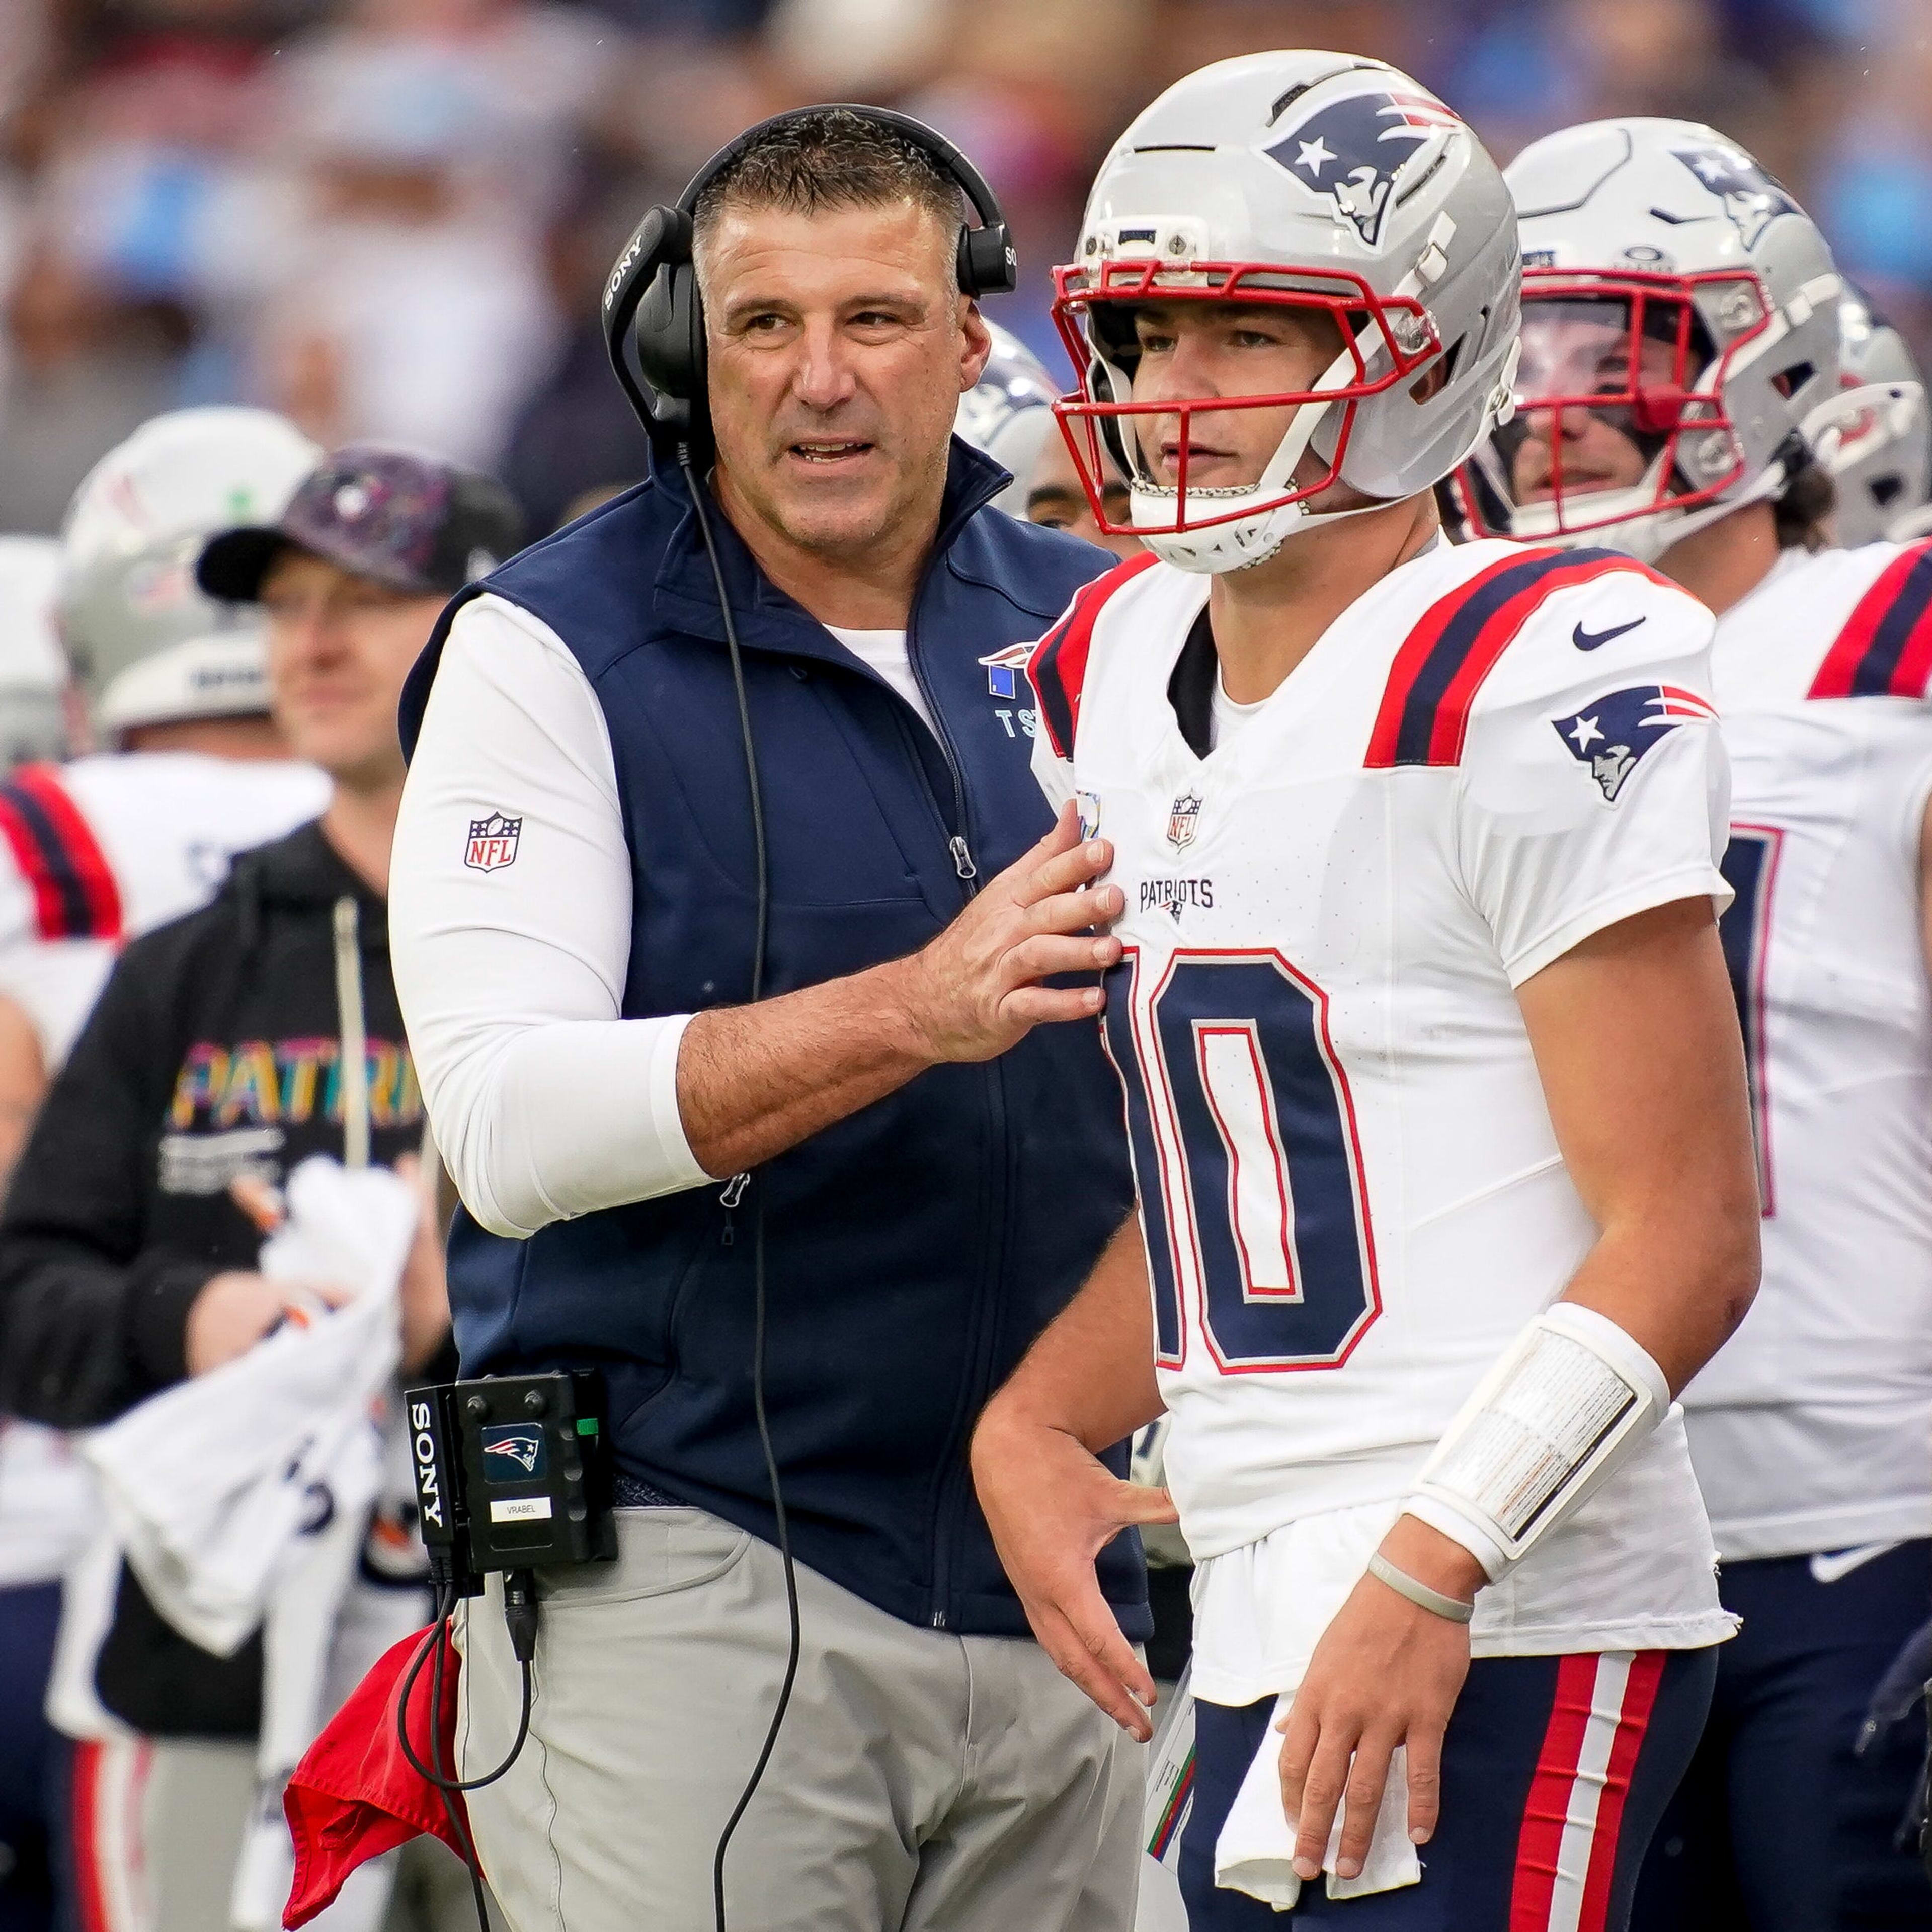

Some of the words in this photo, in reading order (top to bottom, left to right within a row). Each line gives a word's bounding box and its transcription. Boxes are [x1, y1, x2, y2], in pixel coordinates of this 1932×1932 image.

[605, 234, 642, 311] SONY
[995, 709, 1036, 738] TS
[1170, 816, 1191, 840] NFL
[468, 839, 511, 866] NFL
[1140, 879, 1214, 913] PATRIOTS
[411, 1403, 443, 1528] SONY
[506, 1504, 536, 1514] VRABEL
